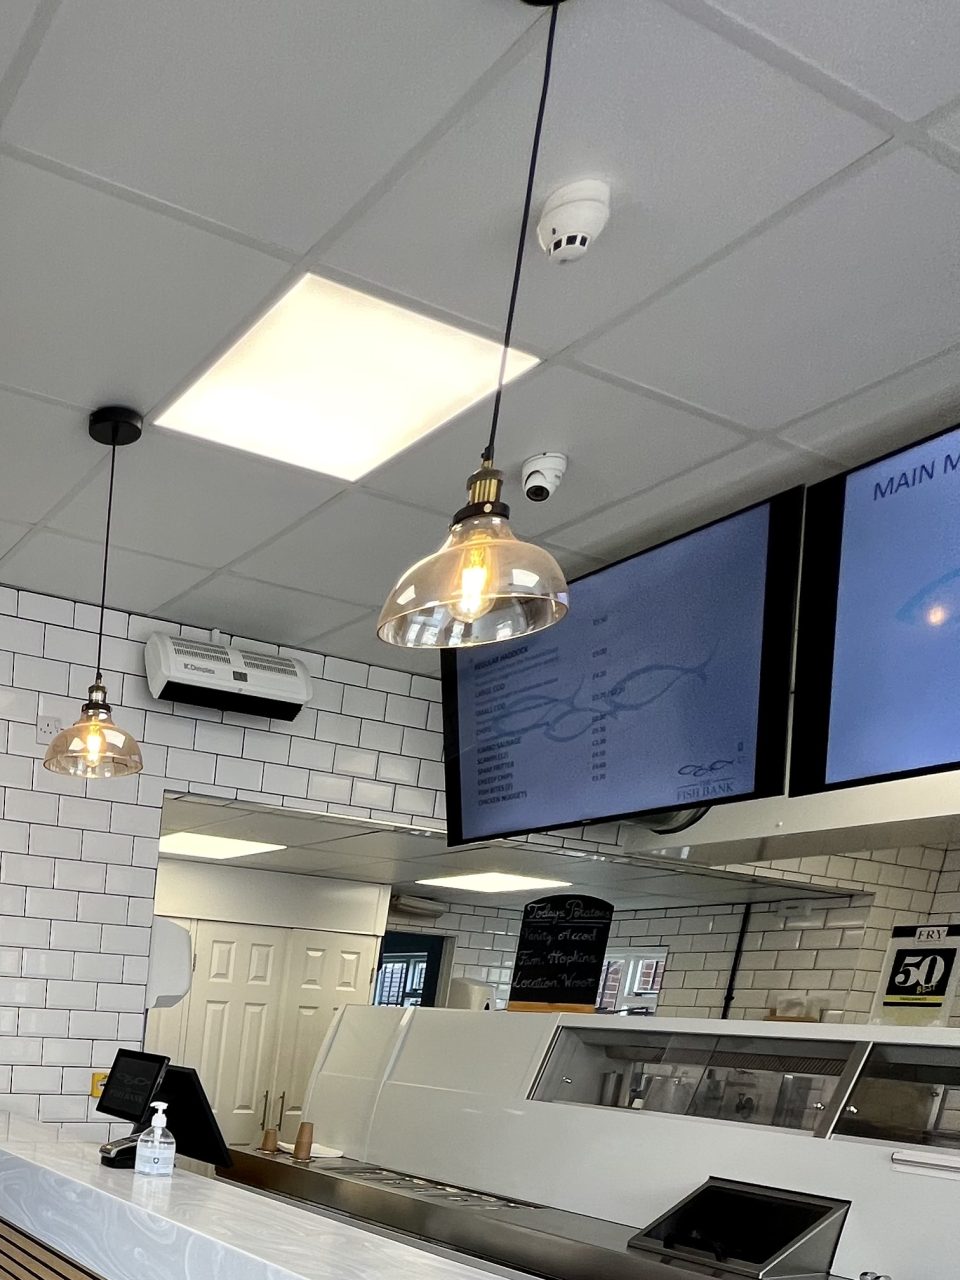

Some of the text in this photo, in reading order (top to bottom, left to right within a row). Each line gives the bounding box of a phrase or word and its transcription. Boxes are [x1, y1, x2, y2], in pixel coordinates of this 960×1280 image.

[874, 460, 936, 501] MAIN
[703, 782, 733, 797] BANK
[917, 929, 946, 939] FRY
[895, 955, 945, 986] 50
